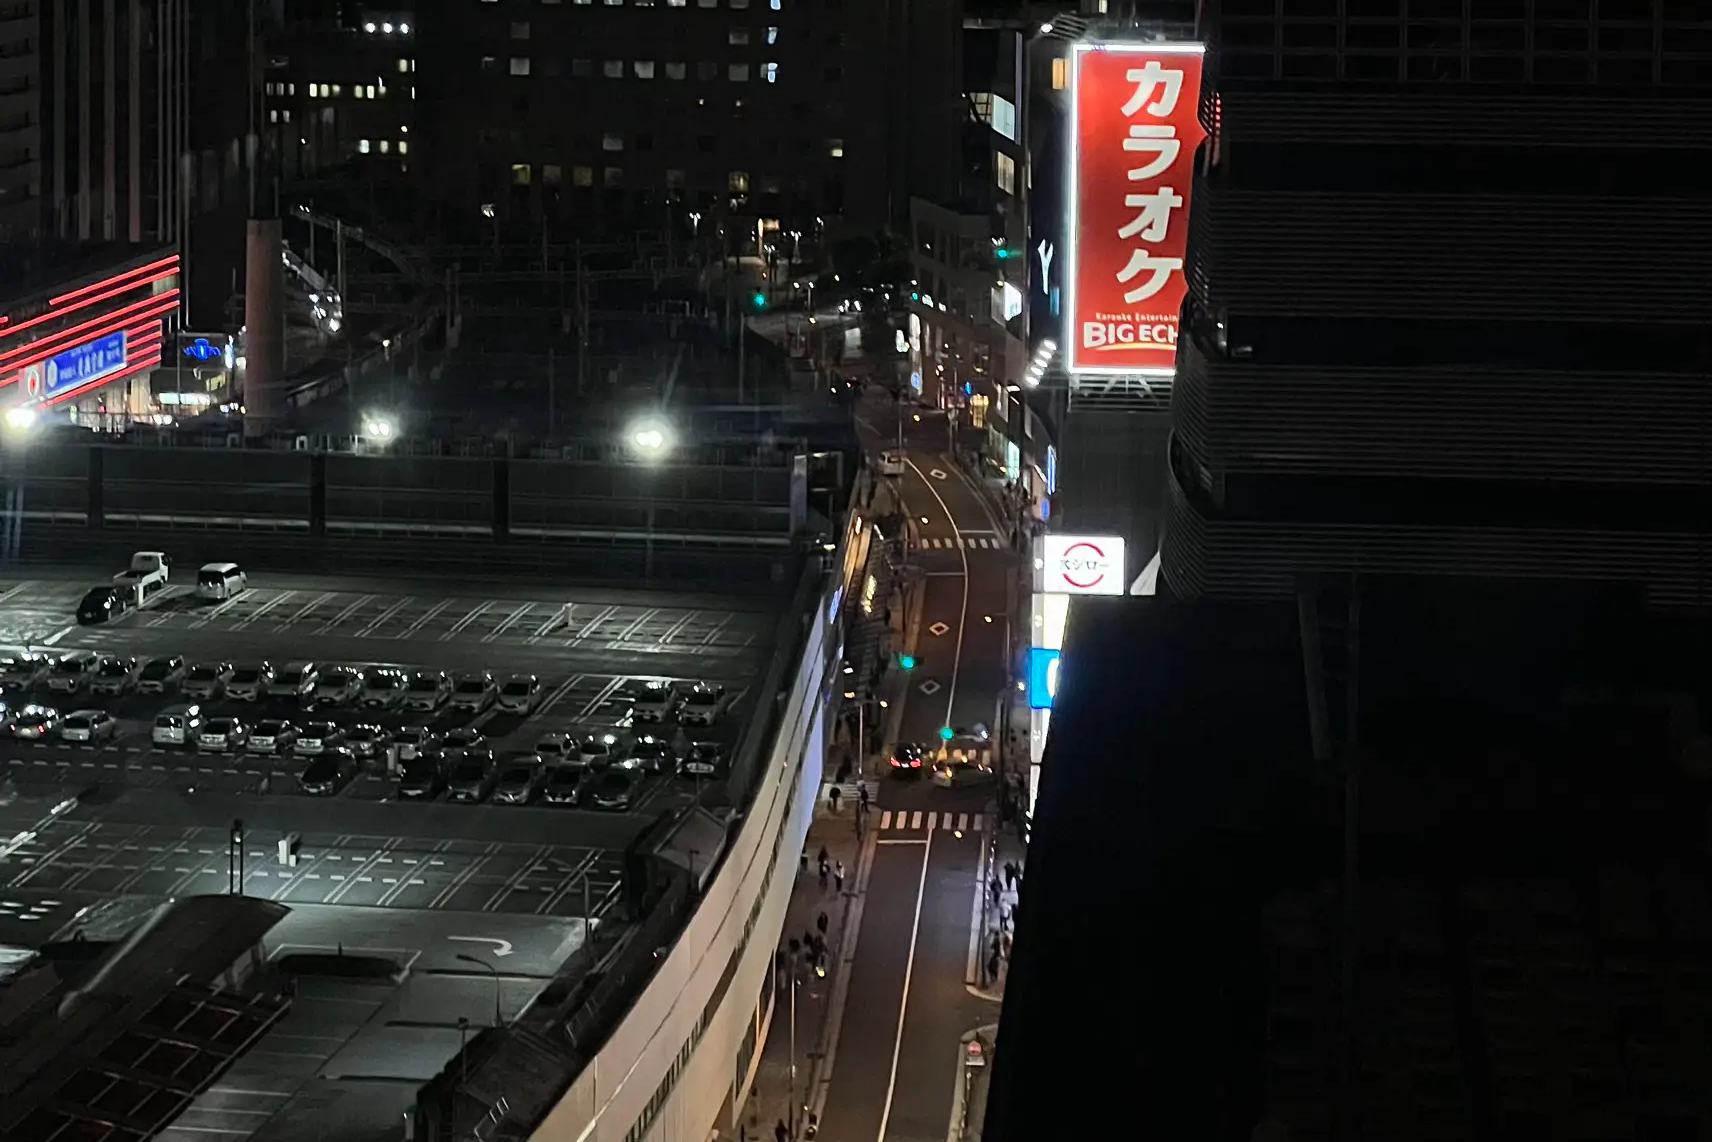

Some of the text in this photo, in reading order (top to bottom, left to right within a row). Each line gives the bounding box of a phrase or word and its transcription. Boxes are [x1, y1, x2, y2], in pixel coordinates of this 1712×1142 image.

[1117, 61, 1184, 304] カラオケ
[1083, 321, 1134, 348] BIG
